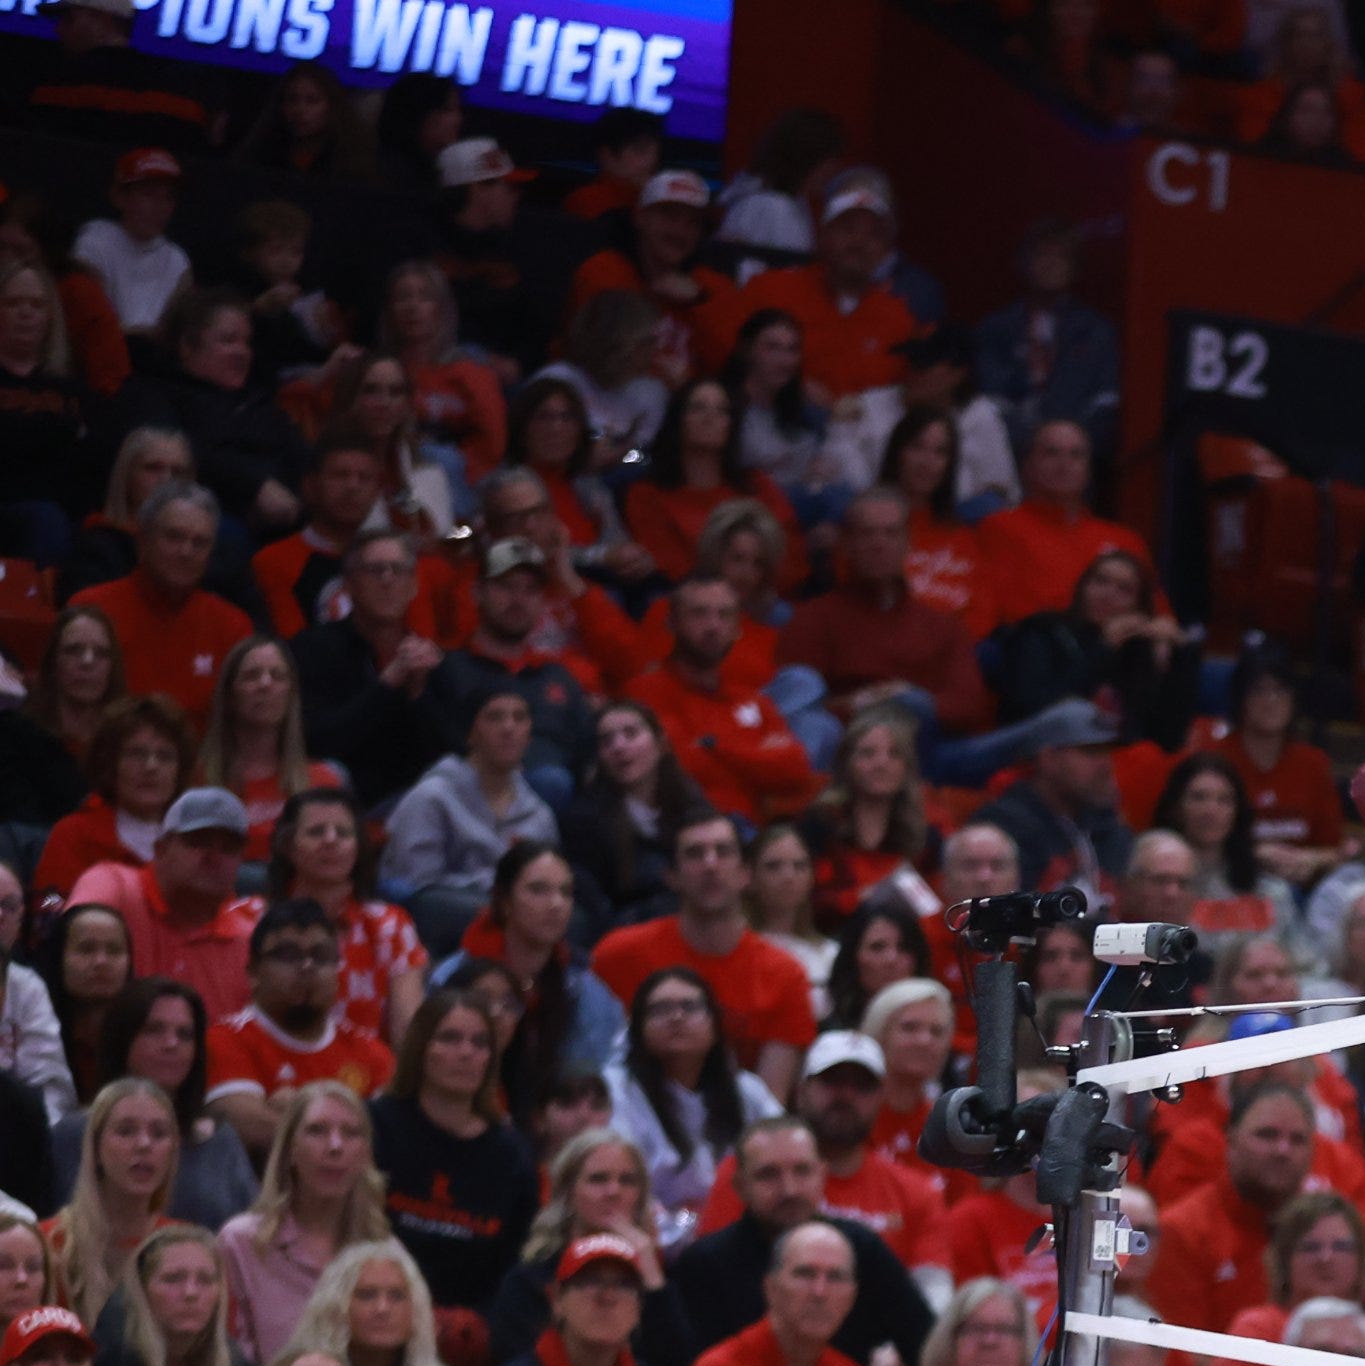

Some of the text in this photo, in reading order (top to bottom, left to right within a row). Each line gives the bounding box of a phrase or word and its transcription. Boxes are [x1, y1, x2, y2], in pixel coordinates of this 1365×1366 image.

[349, 0, 494, 86] WIN
[500, 13, 686, 115] HERE
[1147, 141, 1231, 213] C1
[1189, 325, 1268, 398] B2
